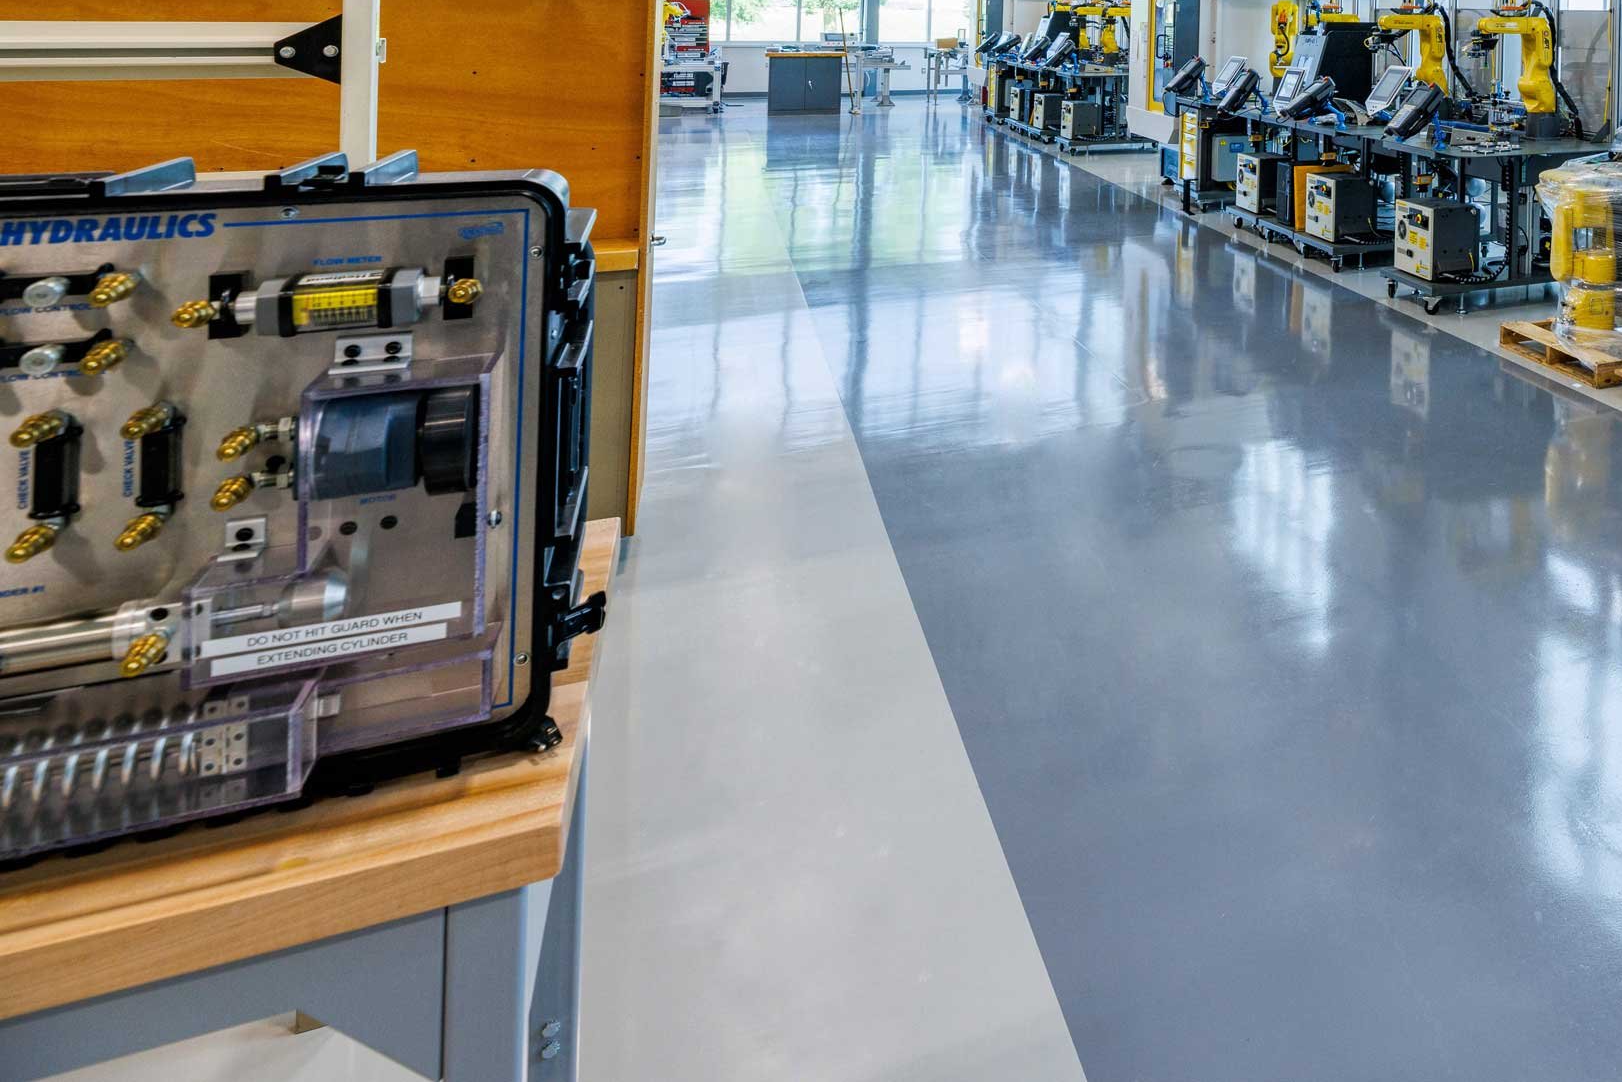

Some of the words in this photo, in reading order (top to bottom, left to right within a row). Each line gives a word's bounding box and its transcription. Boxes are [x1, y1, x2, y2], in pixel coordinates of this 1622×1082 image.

[0, 213, 217, 246] HYDRAULICS
[17, 479, 29, 510] CHECK
[122, 468, 134, 497] CHECK
[247, 635, 268, 648] DO
[272, 629, 301, 644] NOT
[305, 625, 327, 638] HIT
[331, 618, 380, 635] GUARD
[383, 611, 424, 626] WHEN
[256, 644, 338, 666] EXTENDING
[340, 632, 409, 651] CYLINDER
